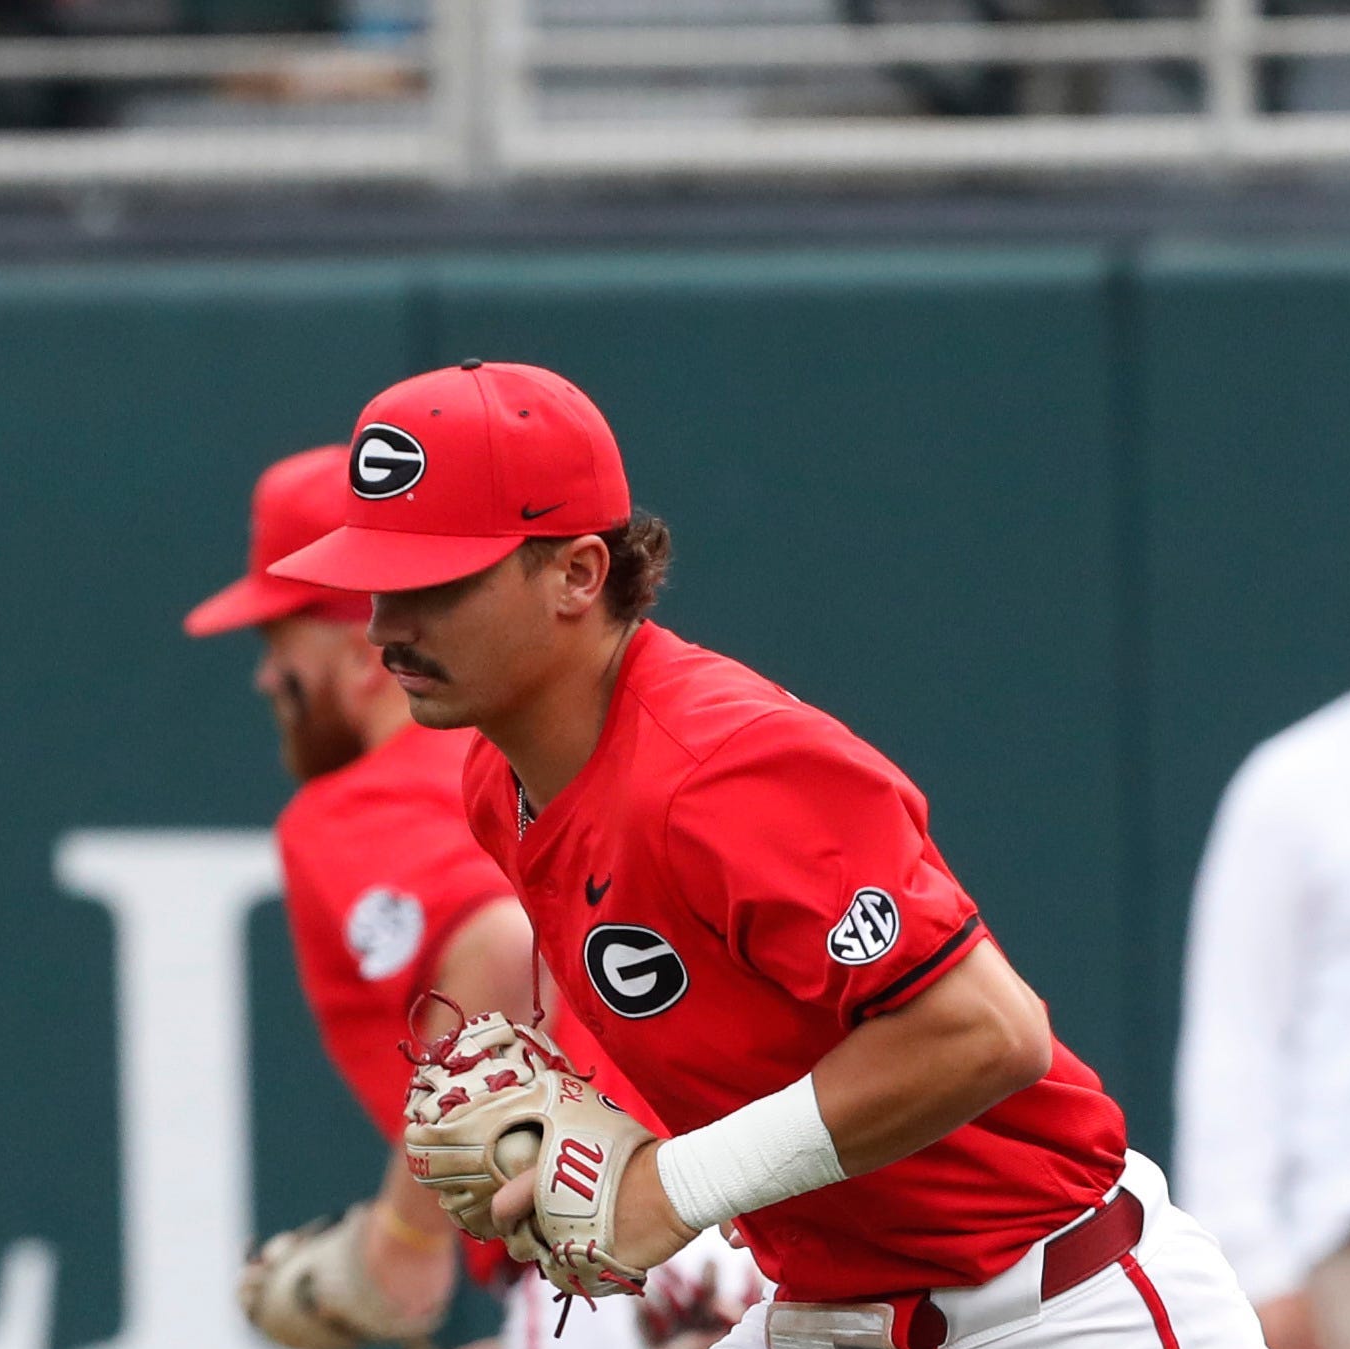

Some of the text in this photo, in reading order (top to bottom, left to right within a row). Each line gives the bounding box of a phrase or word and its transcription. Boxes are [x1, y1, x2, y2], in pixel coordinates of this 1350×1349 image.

[350, 423, 425, 499] G
[831, 892, 896, 961] SEC
[584, 924, 688, 1018] G
